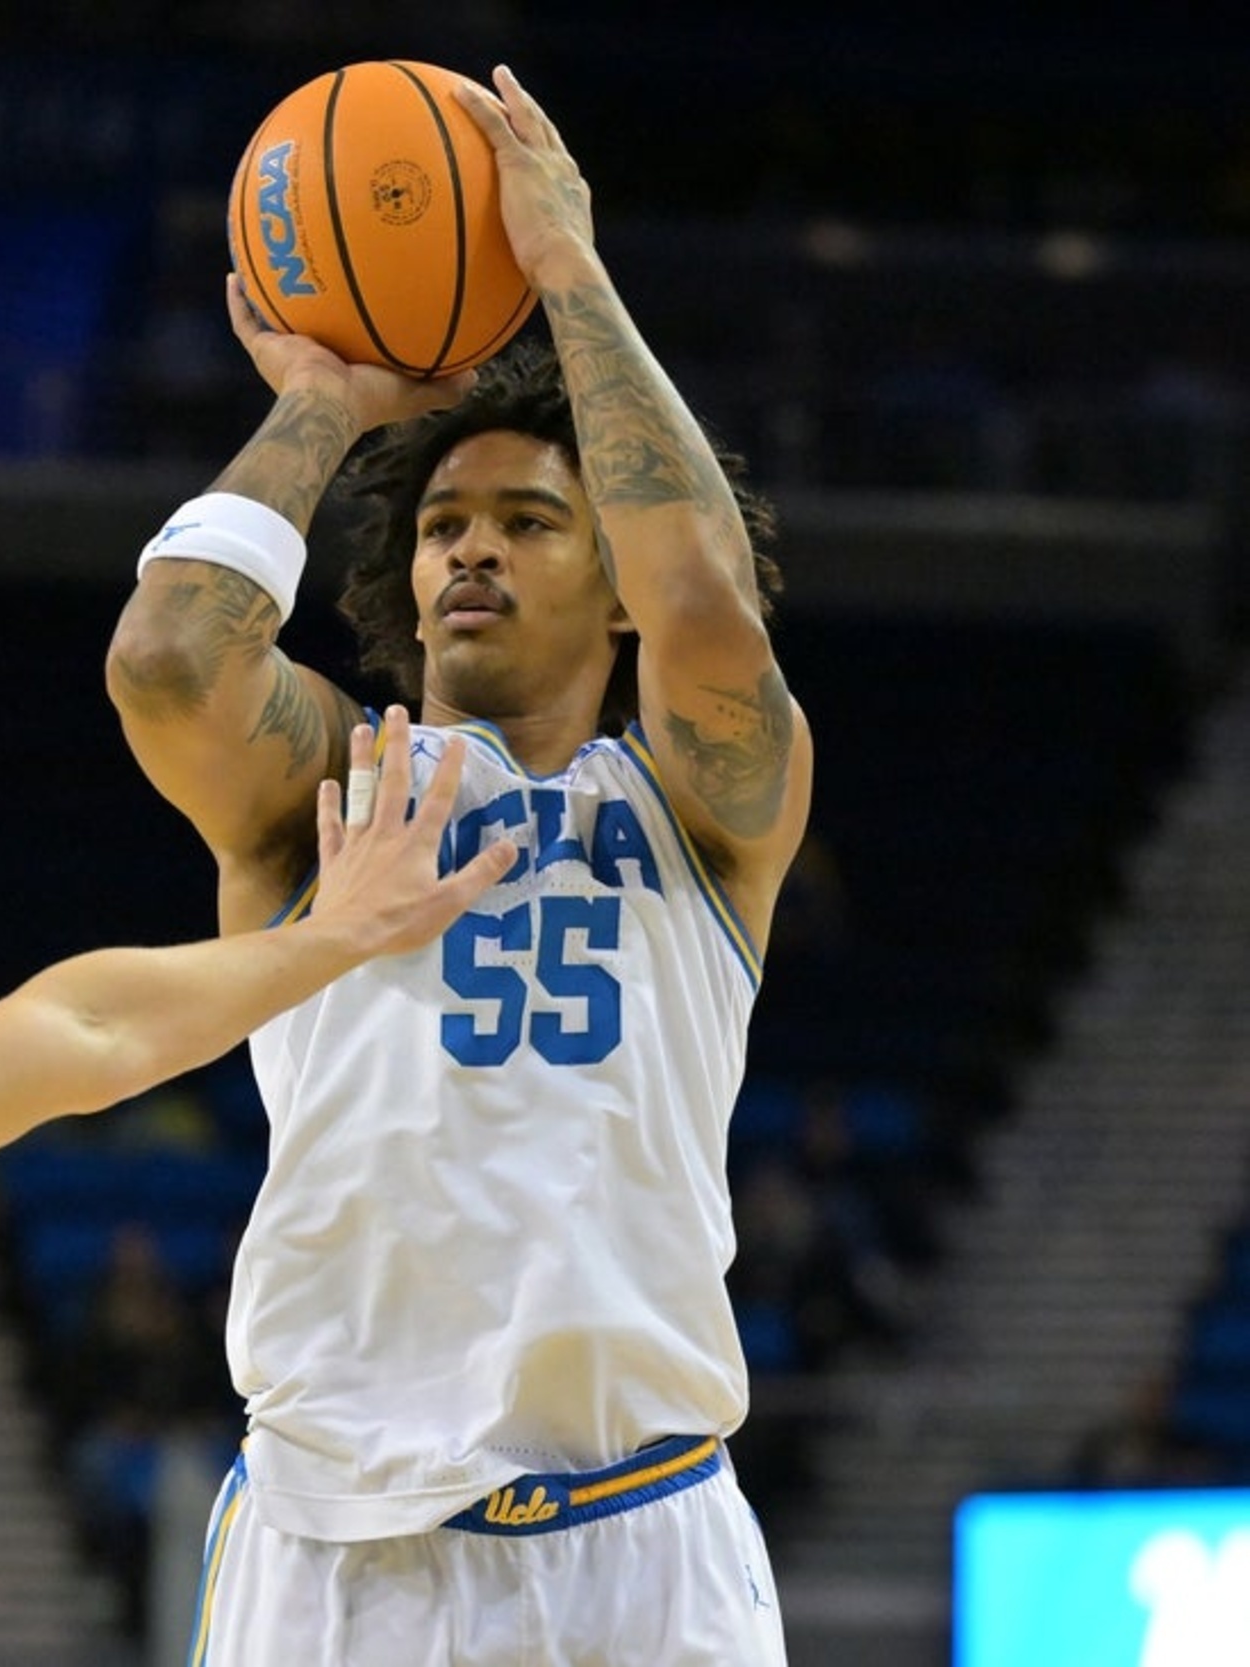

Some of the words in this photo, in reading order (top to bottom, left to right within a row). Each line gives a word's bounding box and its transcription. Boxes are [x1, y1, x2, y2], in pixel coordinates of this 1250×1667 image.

[258, 140, 317, 297] NCAA
[405, 788, 665, 900] CLA
[440, 895, 622, 1067] 55
